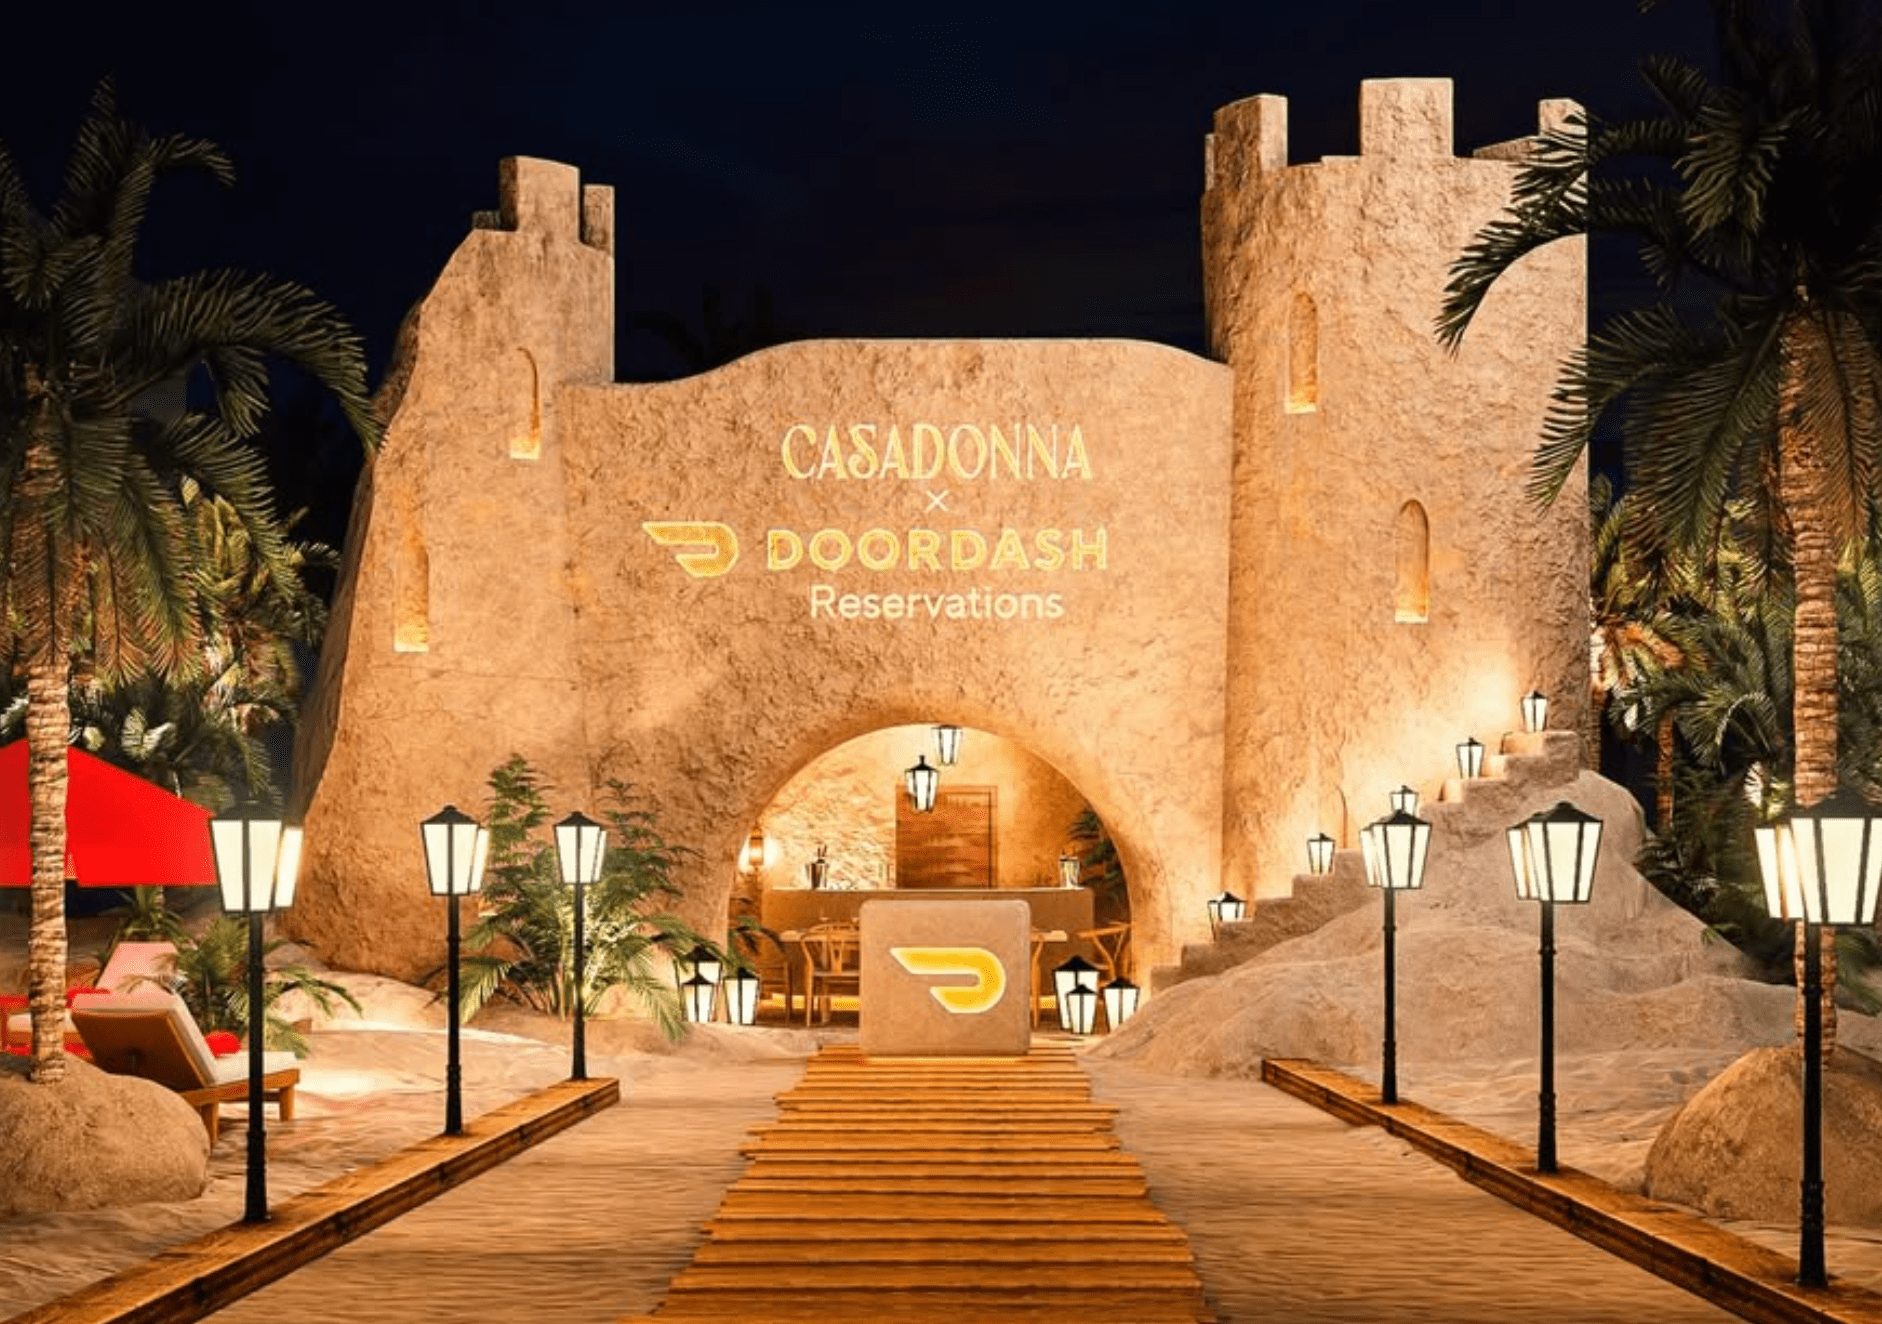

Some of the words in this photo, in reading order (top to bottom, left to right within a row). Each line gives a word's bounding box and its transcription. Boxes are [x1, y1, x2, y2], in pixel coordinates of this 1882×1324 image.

[781, 423, 1093, 481] CASADONNA
[766, 527, 1108, 571] DOORDASH
[810, 585, 1064, 619] Reservations
